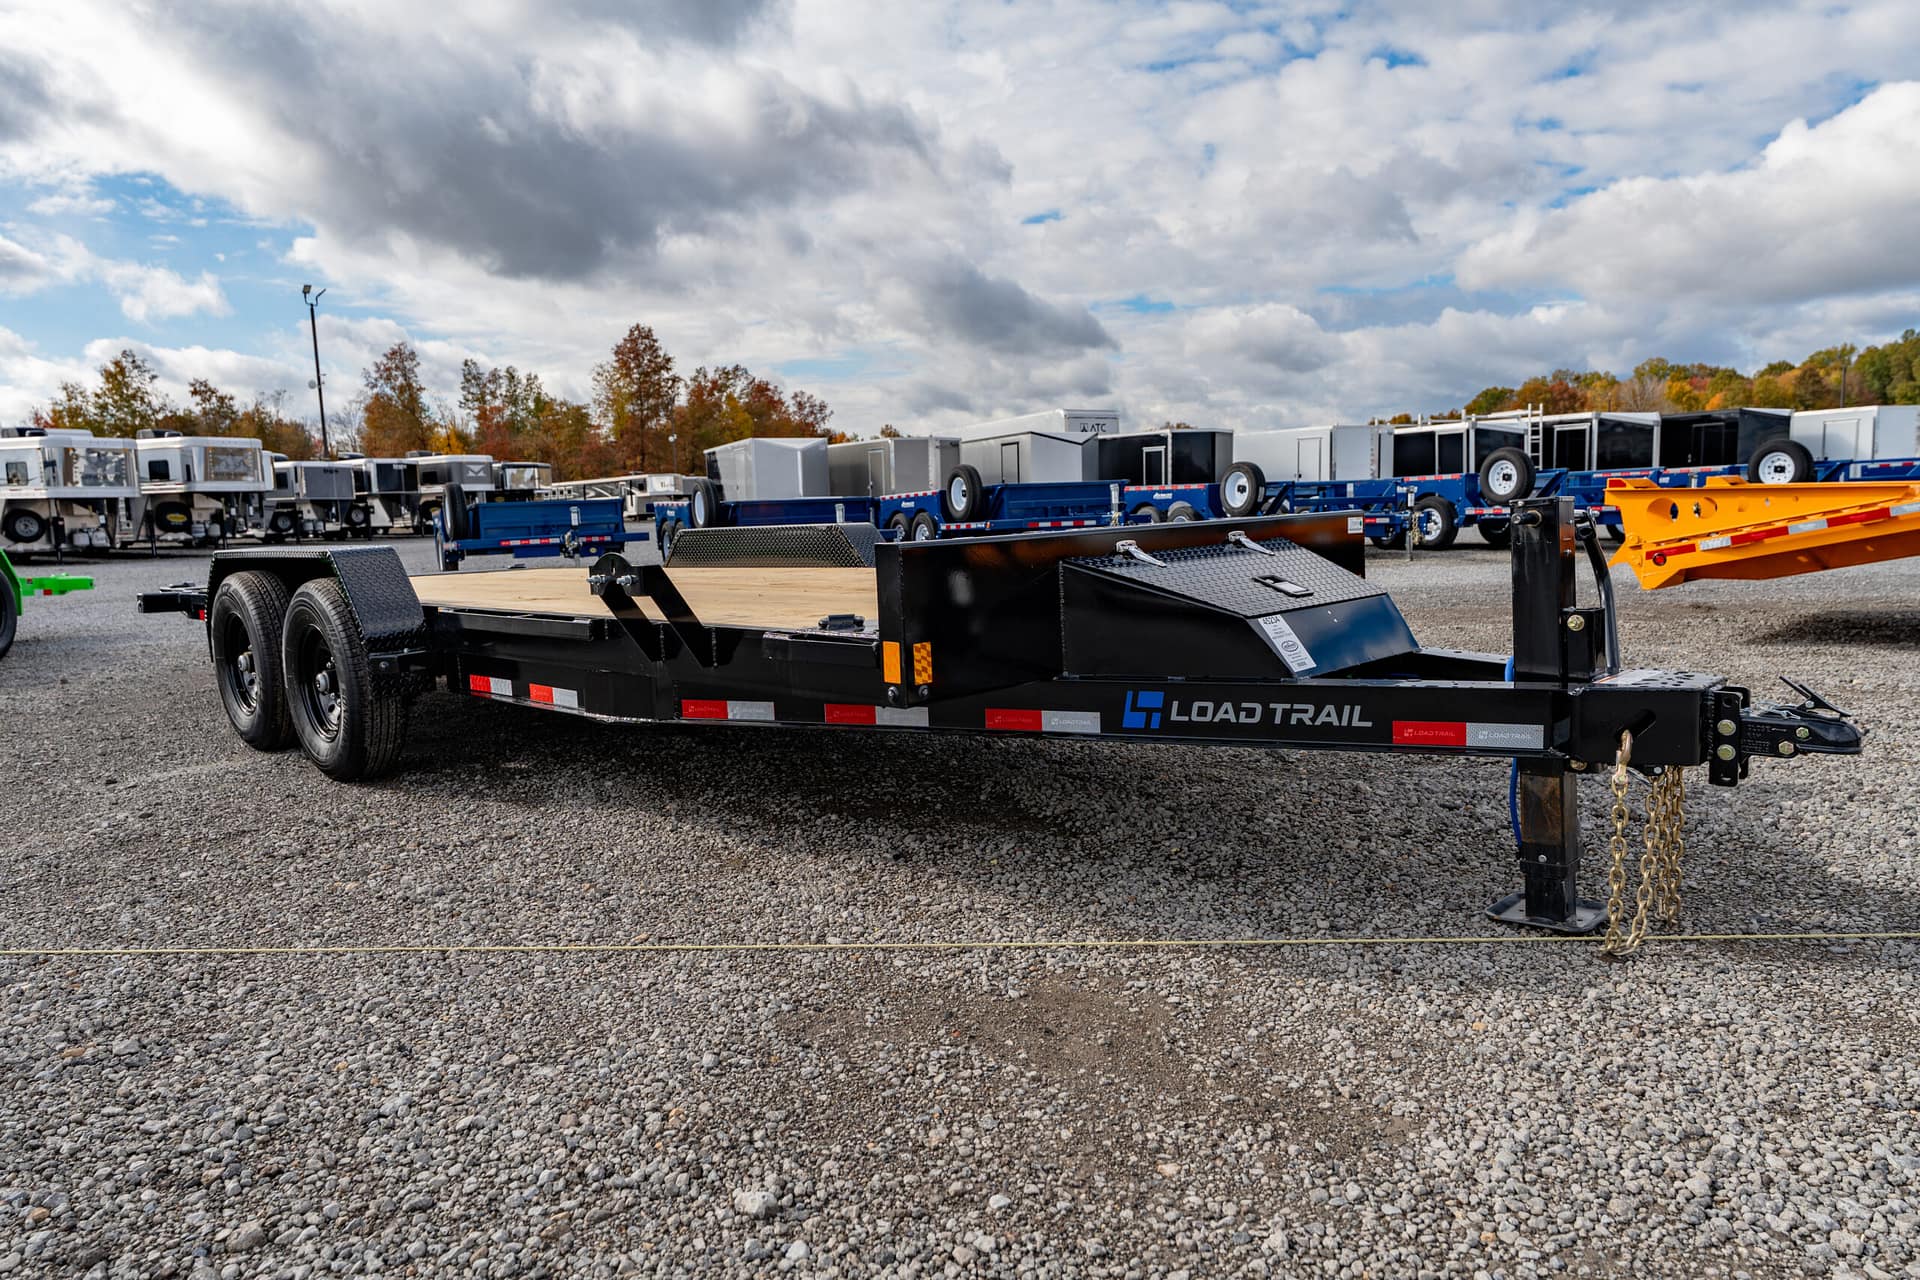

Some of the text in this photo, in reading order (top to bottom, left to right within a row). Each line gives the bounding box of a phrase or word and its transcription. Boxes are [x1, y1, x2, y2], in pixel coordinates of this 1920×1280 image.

[1090, 423, 1106, 432] ATC
[1170, 701, 1372, 727] LOAD TRAIL
